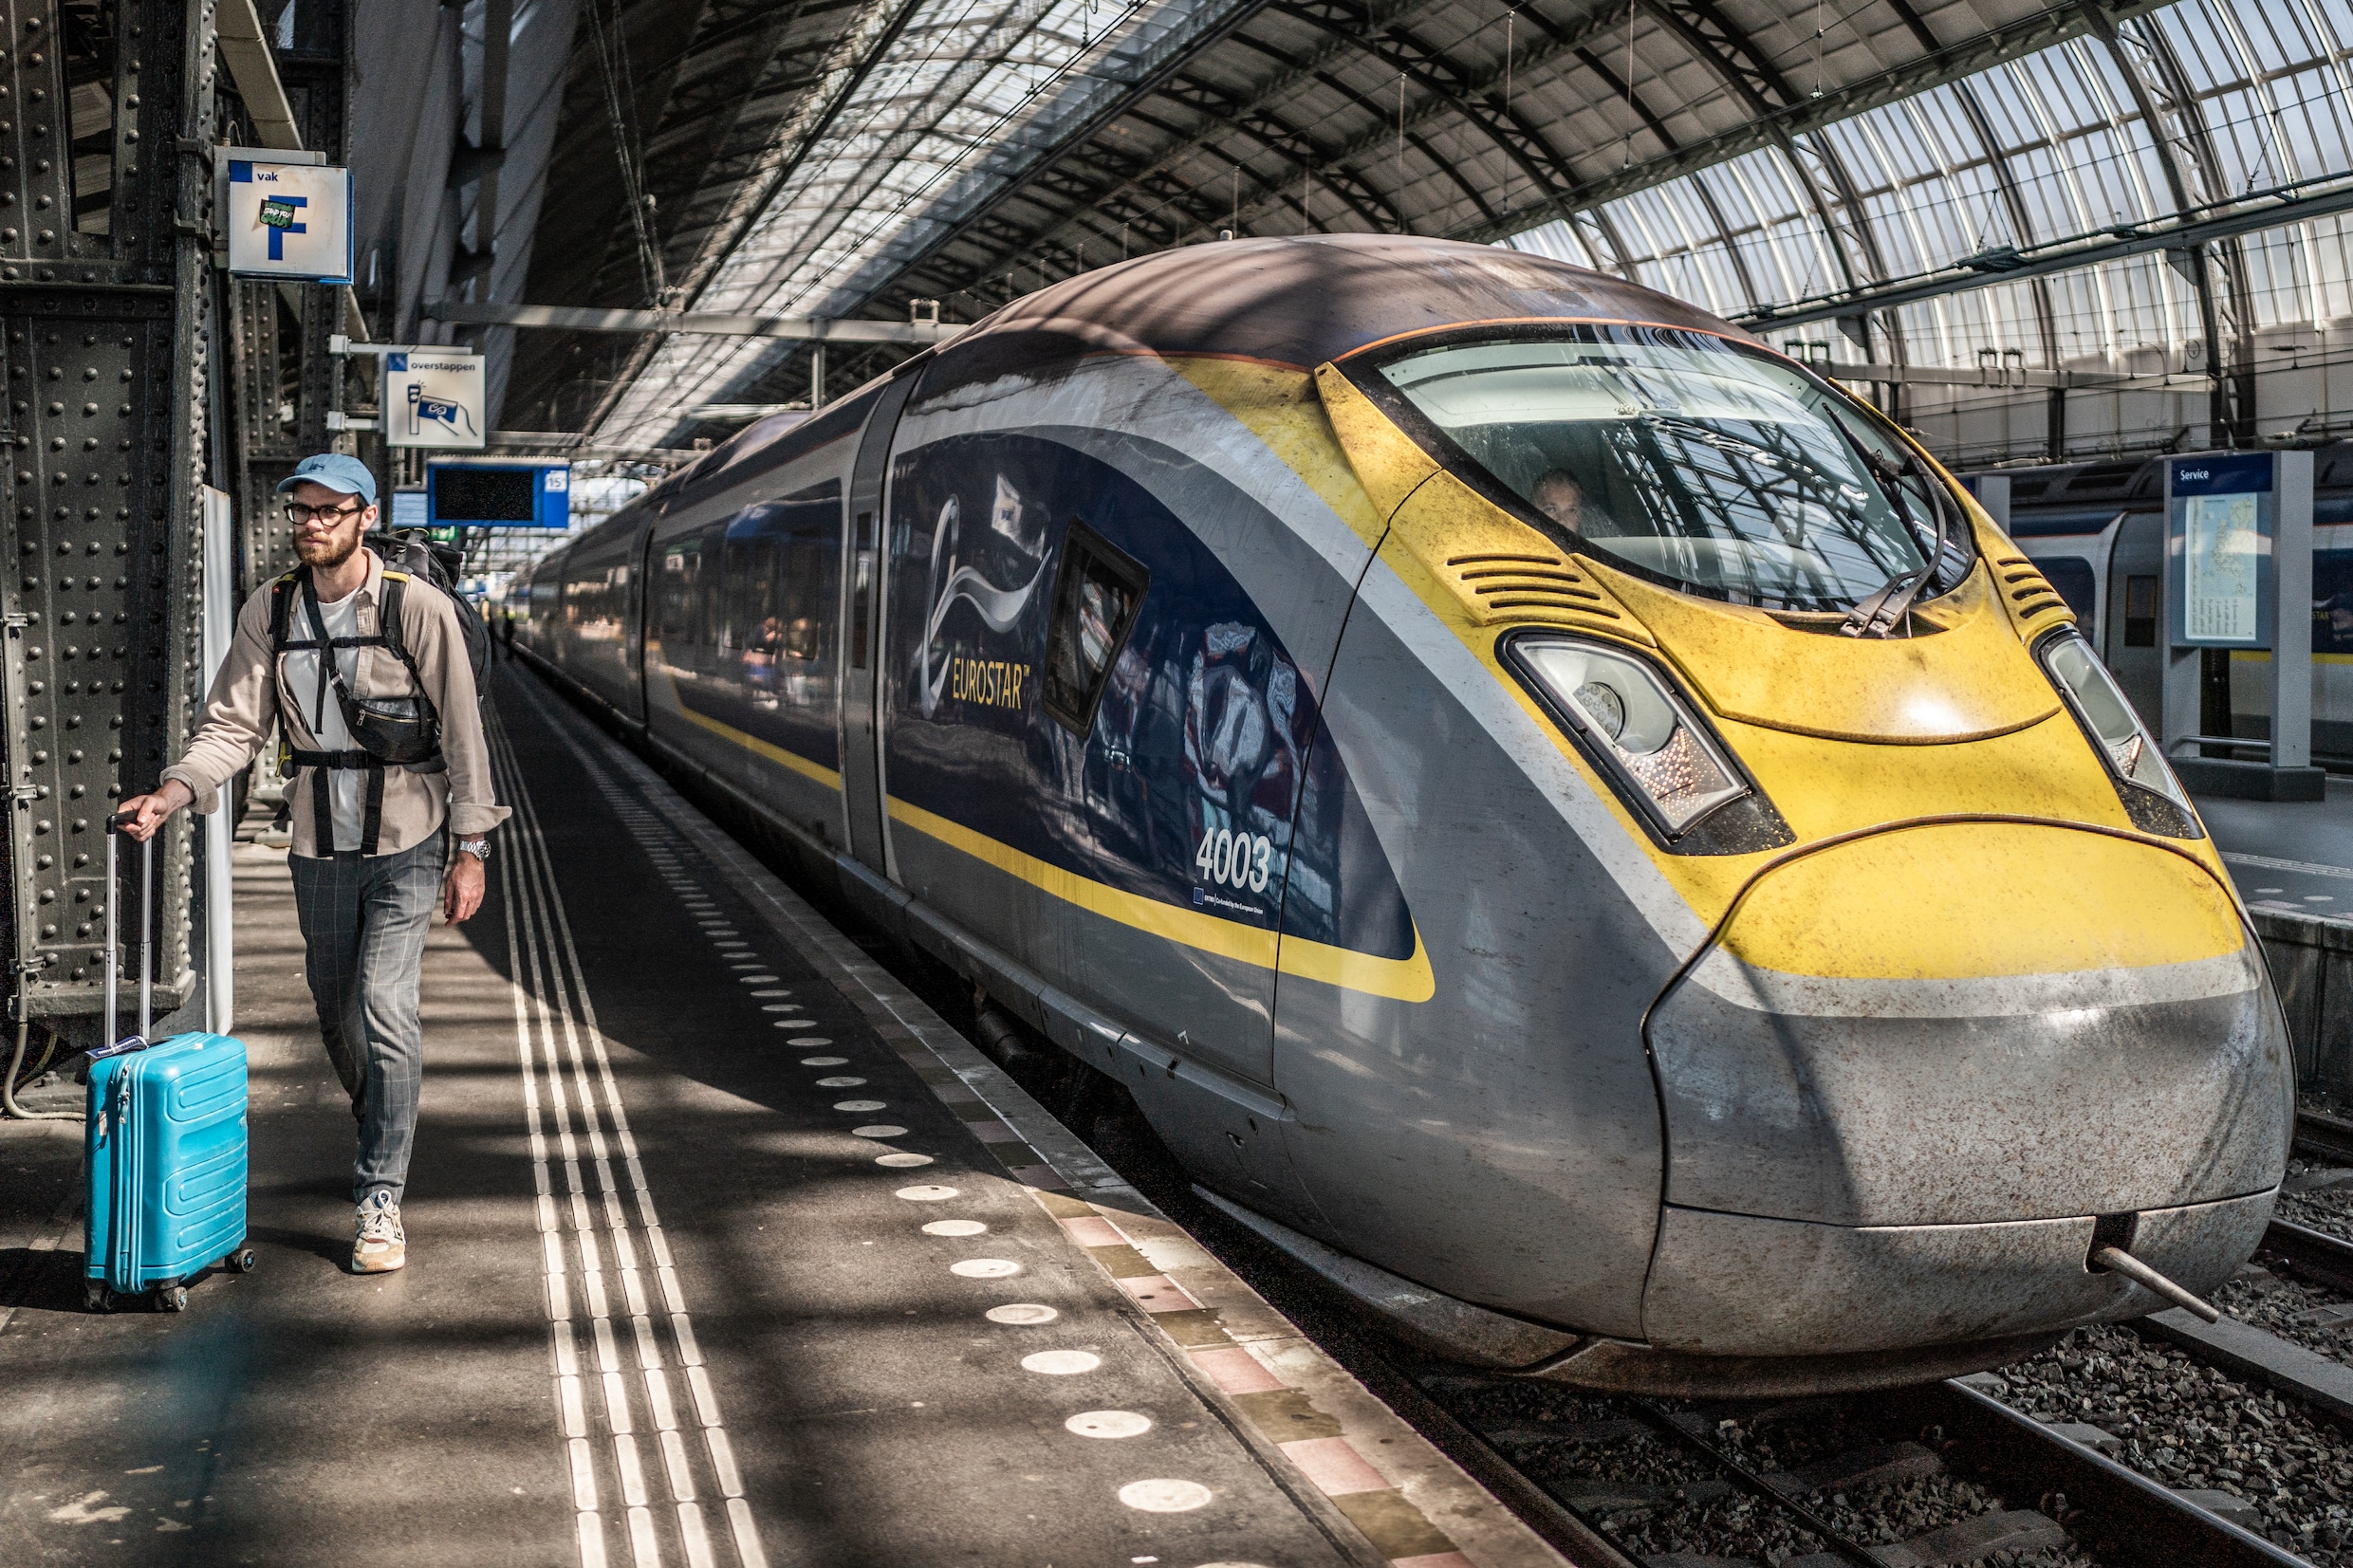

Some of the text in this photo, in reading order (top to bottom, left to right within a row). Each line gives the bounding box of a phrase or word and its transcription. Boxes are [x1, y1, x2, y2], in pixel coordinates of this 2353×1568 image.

[257, 172, 278, 182] vak
[269, 195, 307, 260] F
[411, 362, 475, 372] overstappen
[2180, 469, 2209, 481] Service
[1196, 827, 1270, 893] 4003
